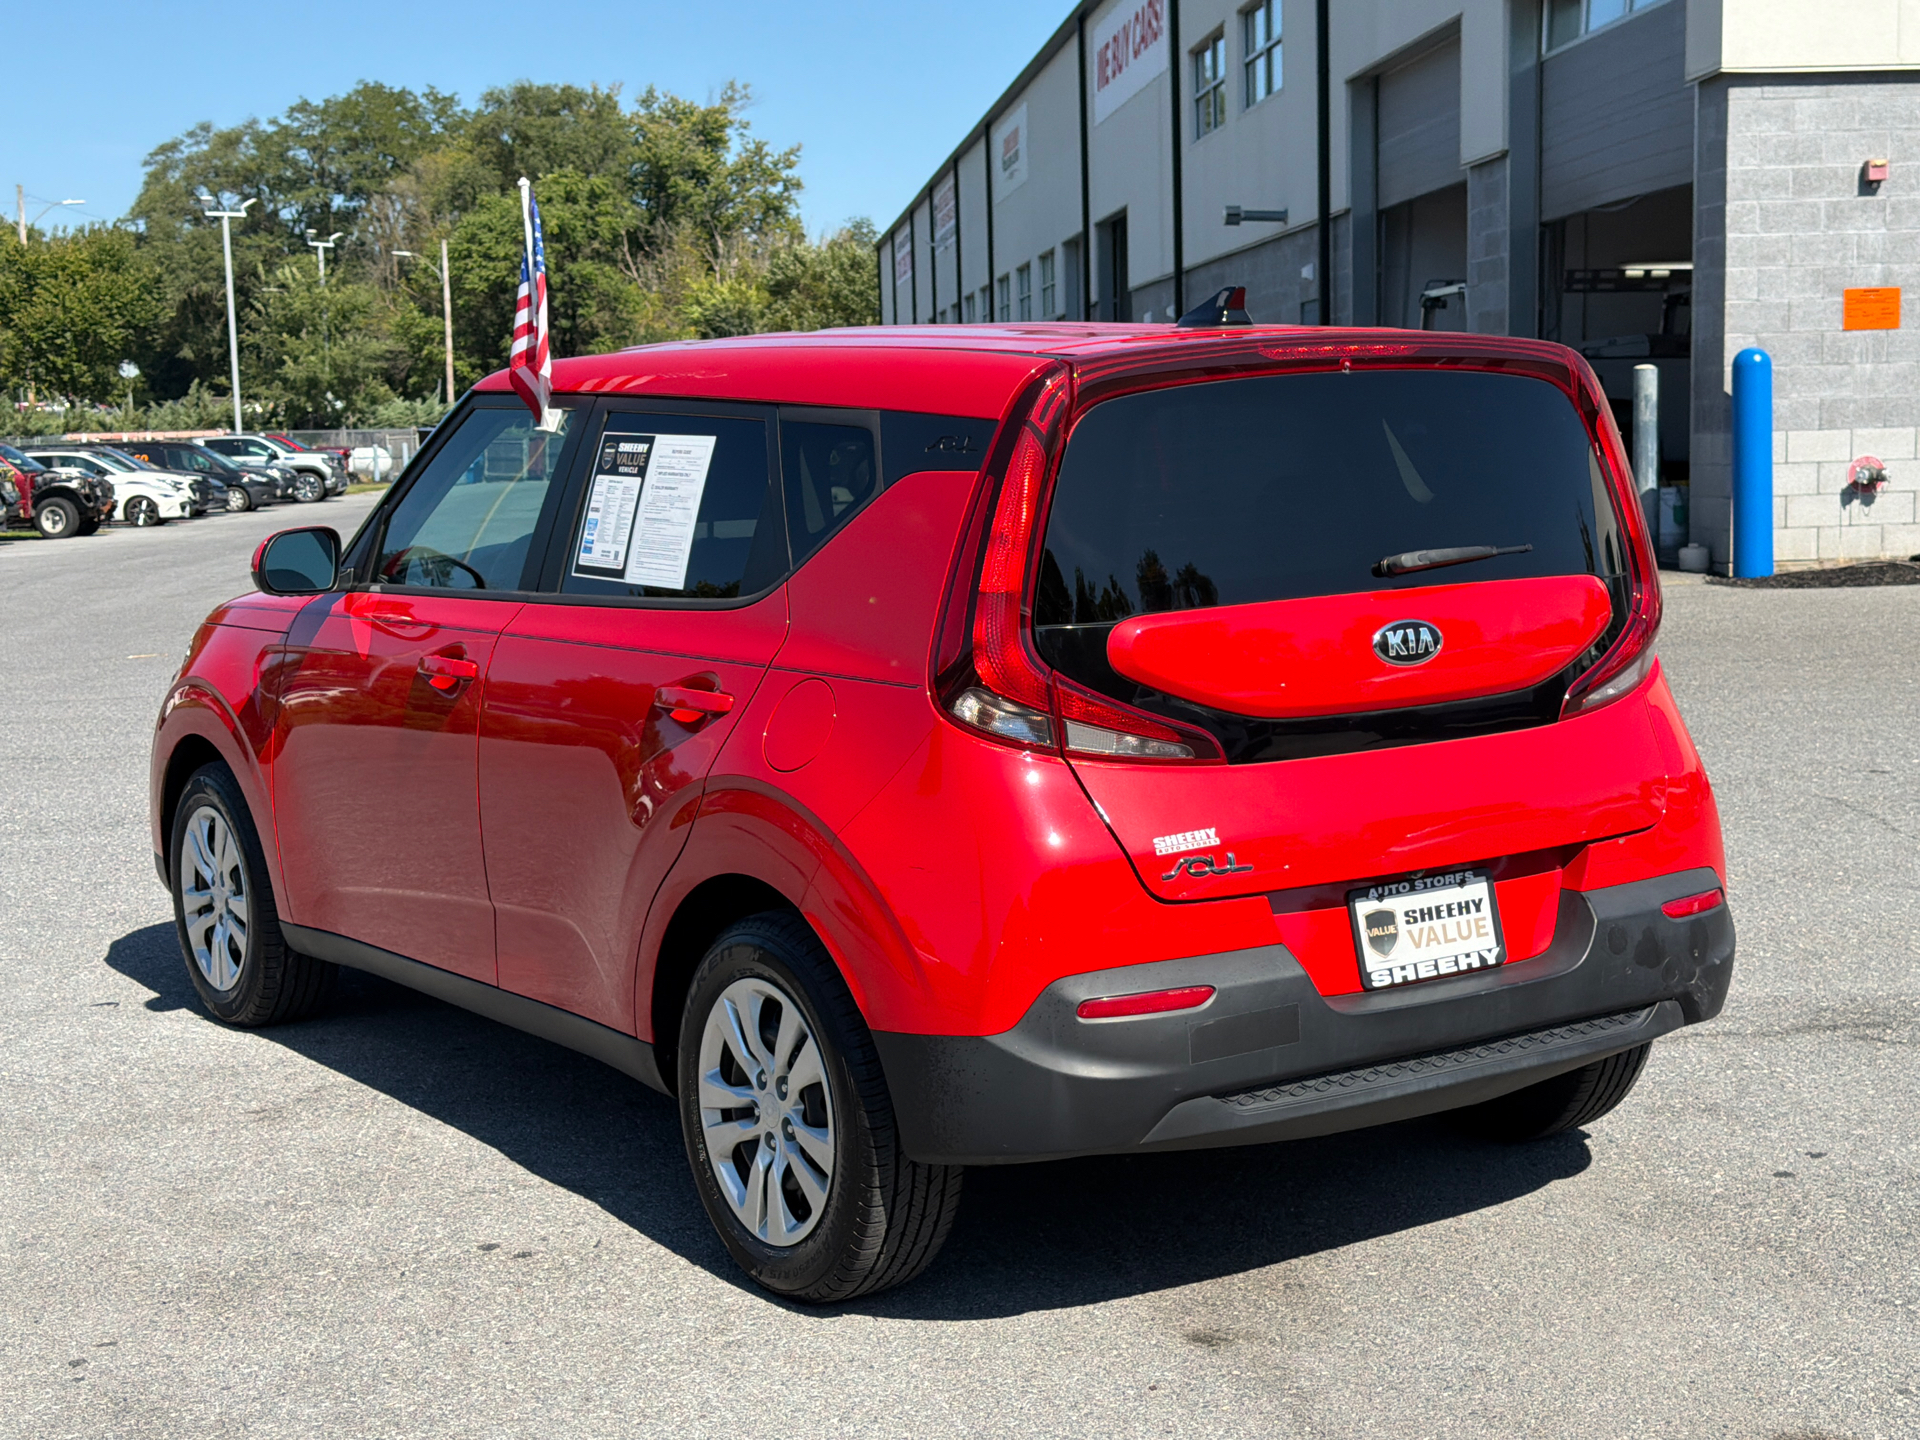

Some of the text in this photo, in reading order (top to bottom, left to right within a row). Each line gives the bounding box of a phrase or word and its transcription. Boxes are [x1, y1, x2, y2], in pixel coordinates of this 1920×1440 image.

[1111, 19, 1132, 79] BUY
[618, 442, 650, 453] SHEEHY
[616, 453, 647, 466] VALUE
[618, 466, 639, 474] VEHICLE
[1385, 627, 1435, 657] KIA
[1153, 827, 1216, 848] SHEEHY
[1158, 839, 1218, 854] AUTO STORES
[1368, 882, 1410, 899] AUTO
[1404, 897, 1484, 926] SHEEHY
[1367, 924, 1398, 938] VALUE
[1406, 916, 1490, 949] VALUE
[1370, 947, 1501, 988] SHEEHY
